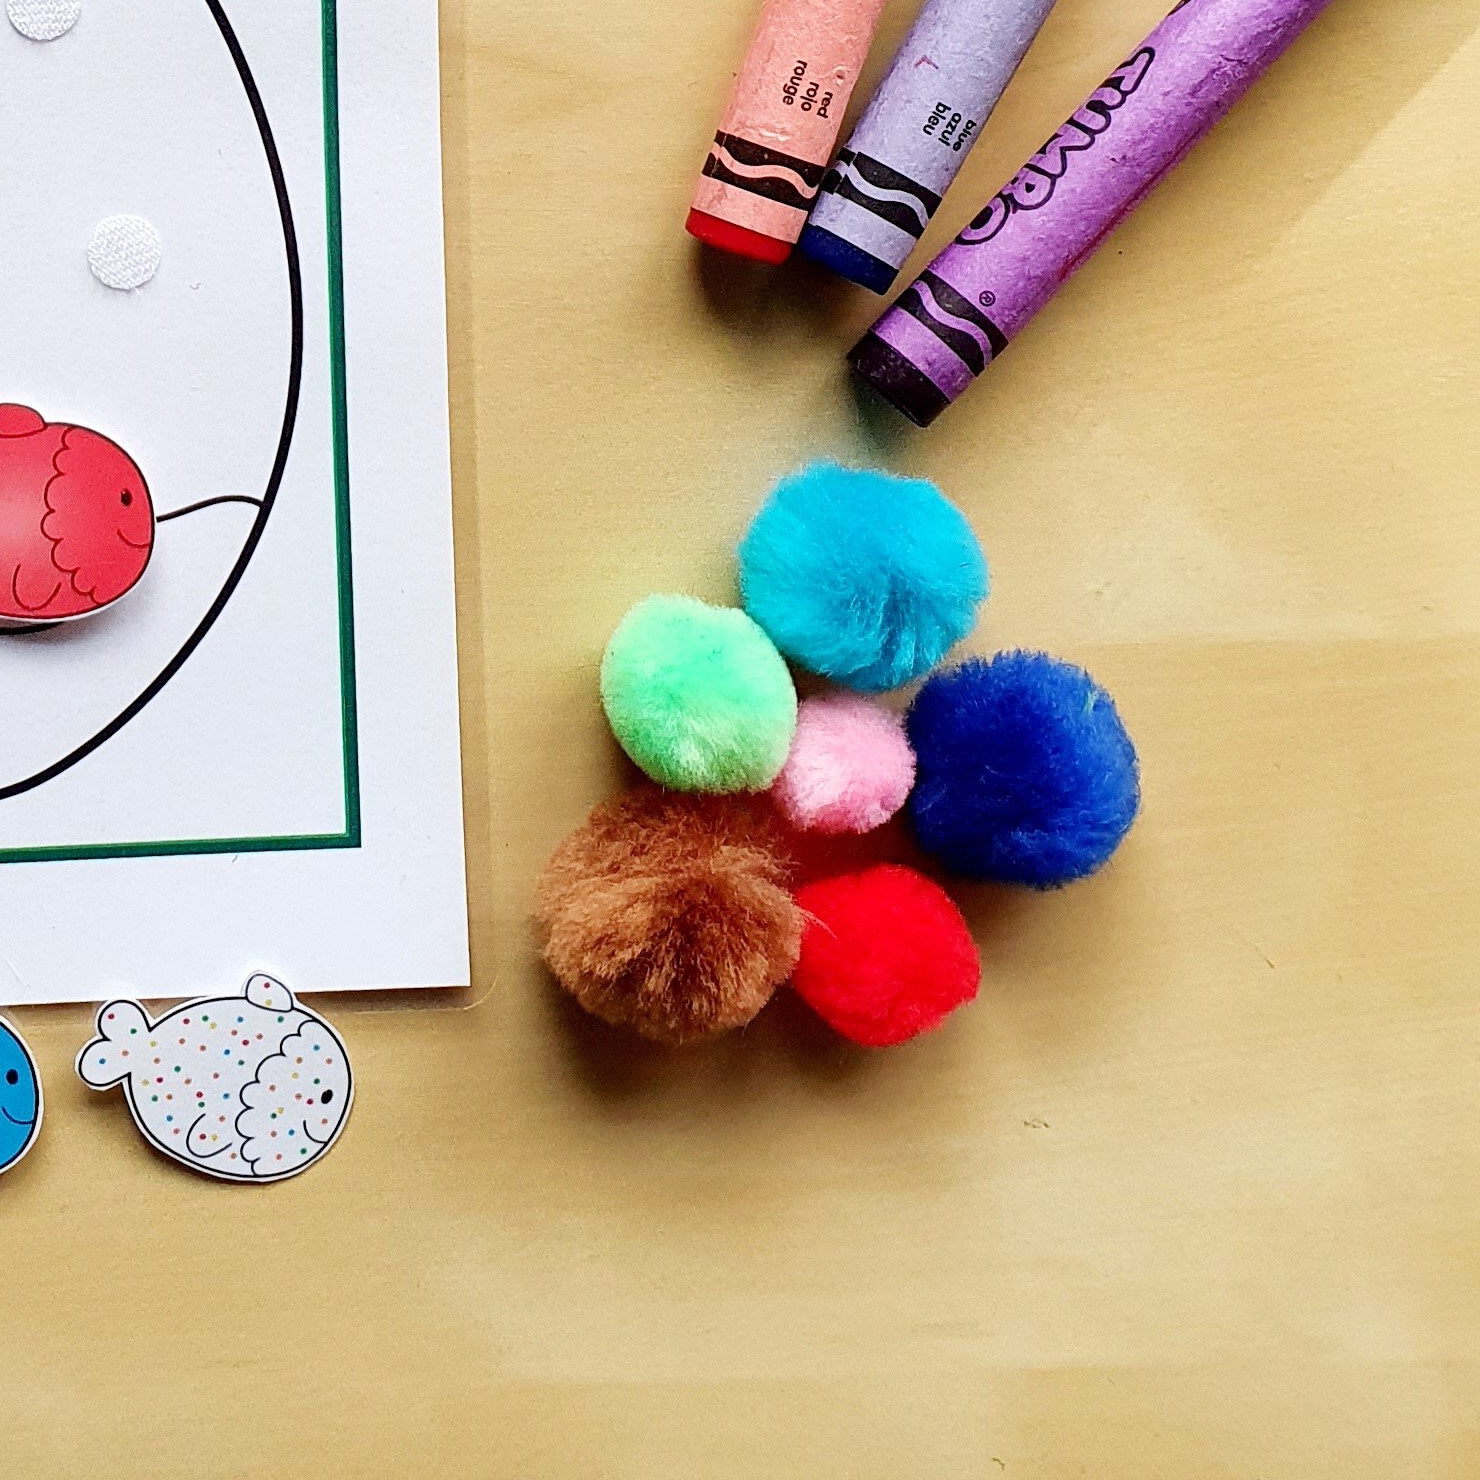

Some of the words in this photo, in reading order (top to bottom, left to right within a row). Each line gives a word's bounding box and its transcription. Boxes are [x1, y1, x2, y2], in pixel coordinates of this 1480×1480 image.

[782, 59, 808, 106] rouge
[799, 81, 820, 112] rojo
[816, 91, 834, 119] red
[922, 101, 952, 136] bleu
[937, 112, 962, 147] azul
[952, 119, 977, 152] blue
